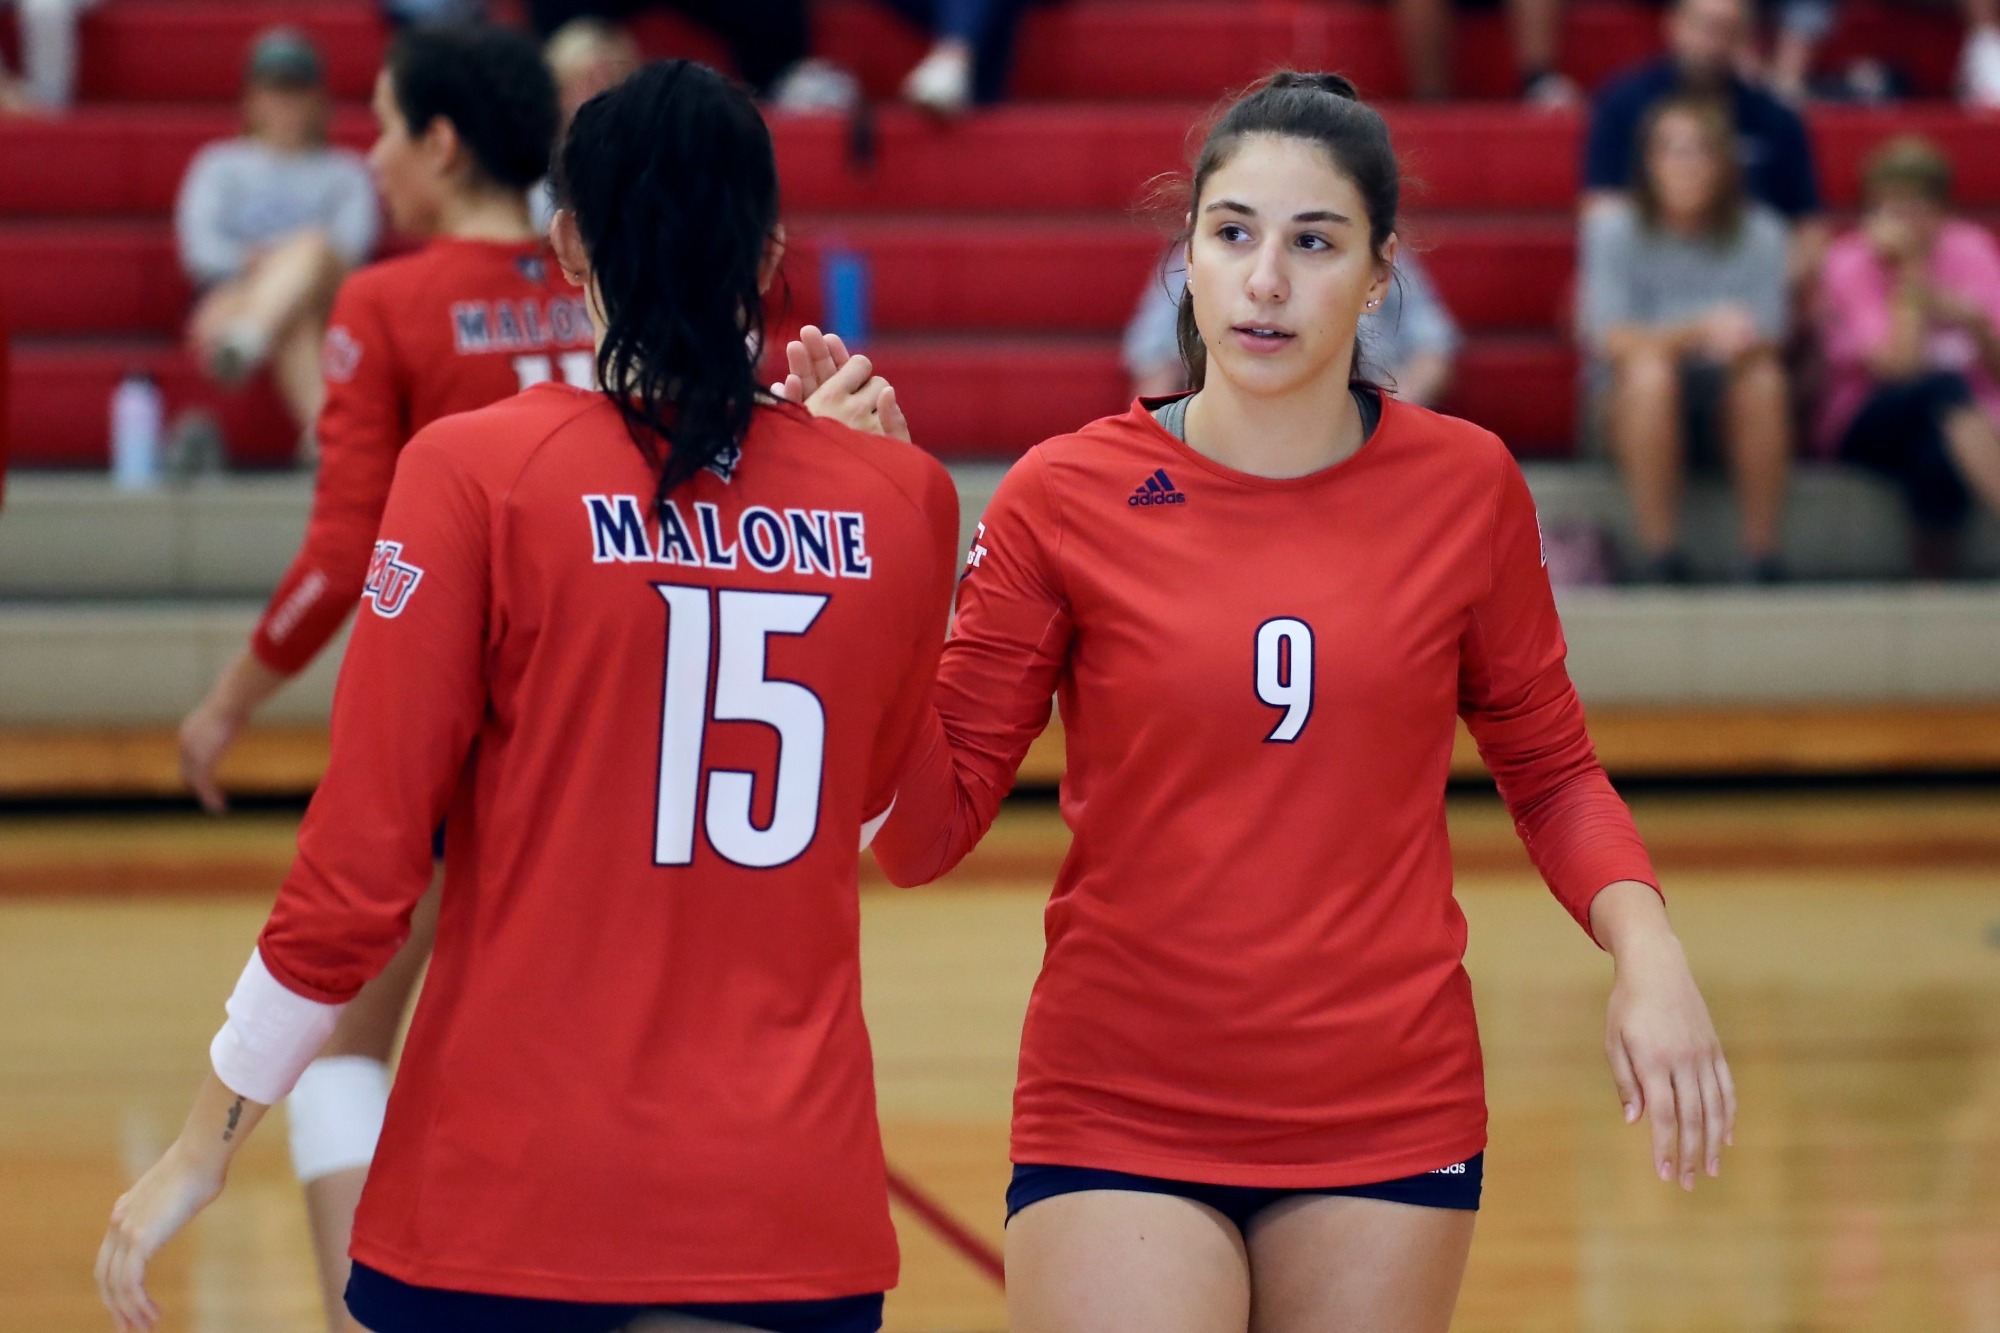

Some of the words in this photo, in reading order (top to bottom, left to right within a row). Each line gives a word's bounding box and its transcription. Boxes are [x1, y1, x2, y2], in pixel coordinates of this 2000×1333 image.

[582, 494, 872, 580] MALONE
[1127, 490, 1186, 506] adidas
[648, 581, 832, 870] 15
[1254, 616, 1315, 744] 9
